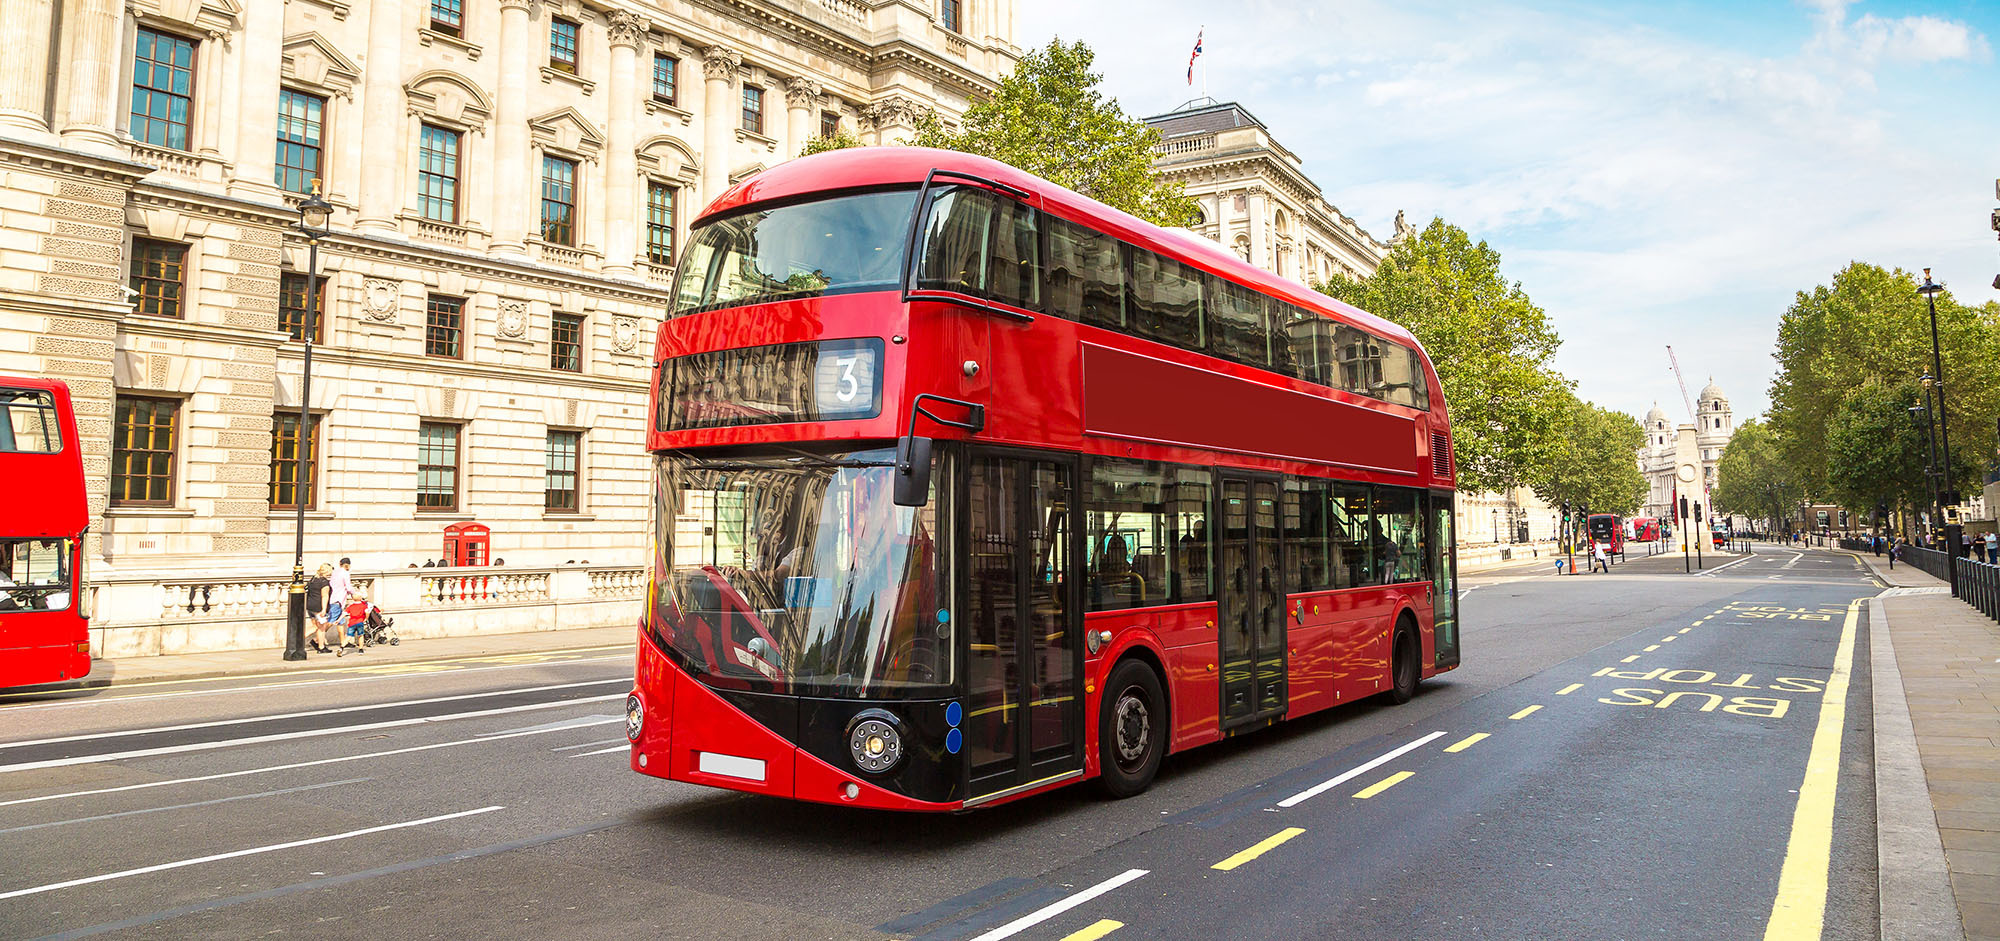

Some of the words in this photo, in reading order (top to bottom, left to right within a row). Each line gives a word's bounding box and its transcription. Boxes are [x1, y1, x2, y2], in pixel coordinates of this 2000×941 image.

[835, 358, 858, 402] 3
[1731, 605, 1845, 615] STOP
[1736, 611, 1831, 622] BUS
[1607, 667, 1826, 693] STOP
[1597, 687, 1791, 719] BUS
